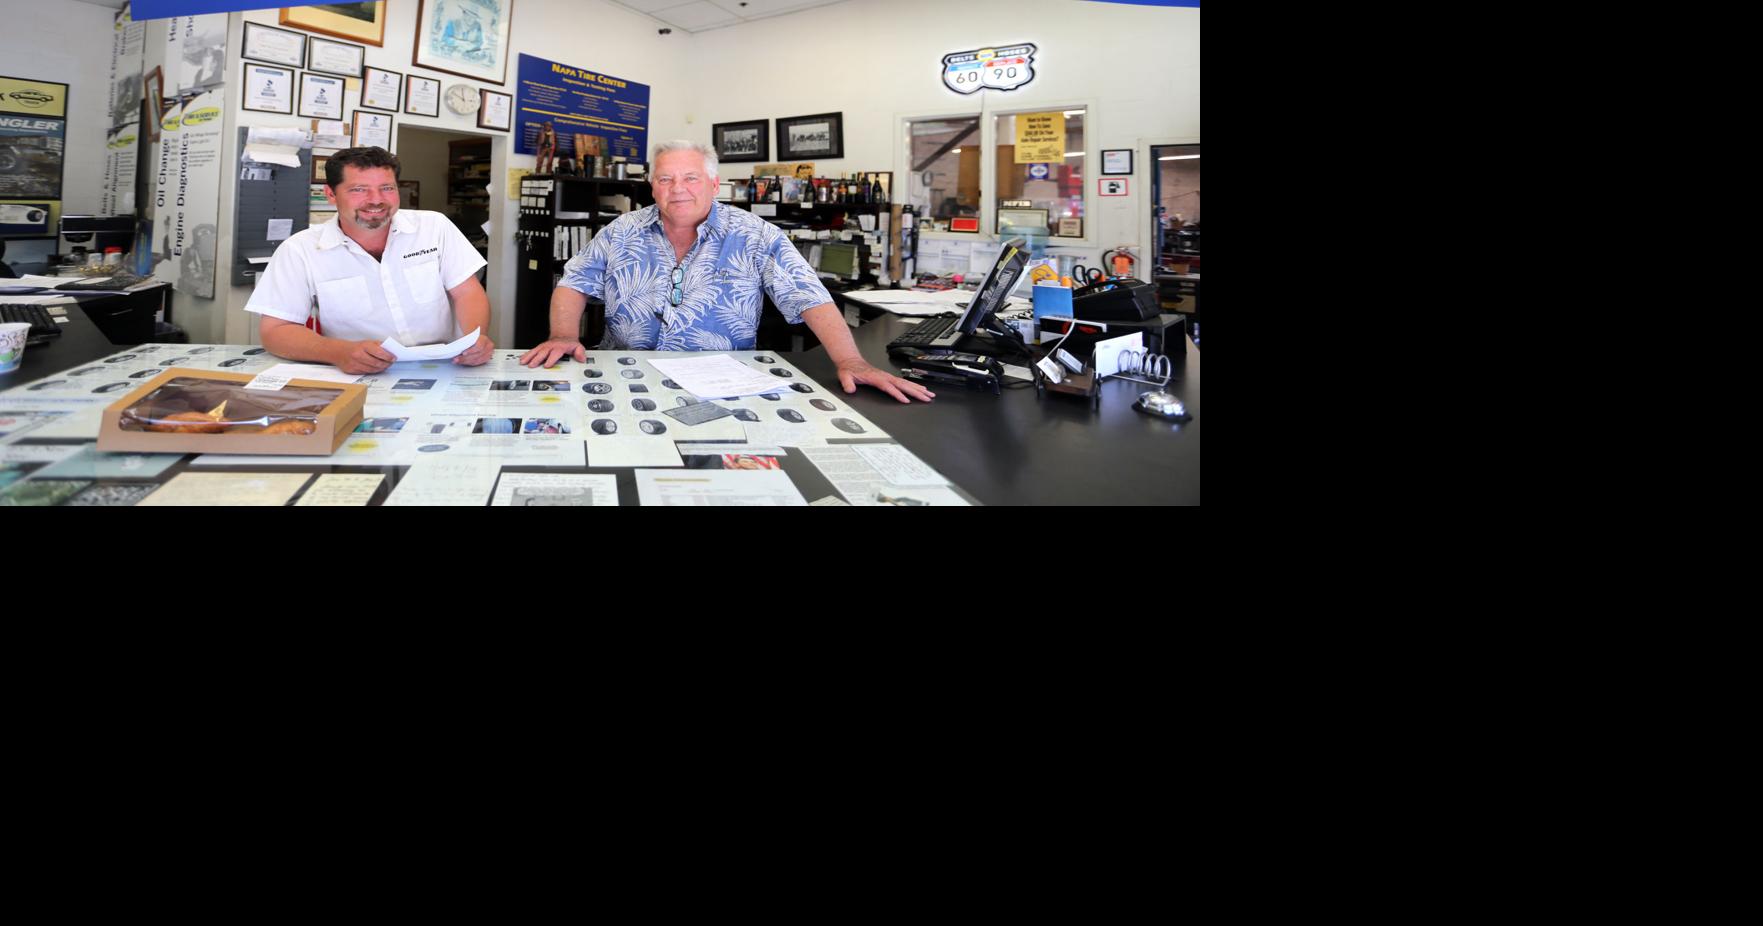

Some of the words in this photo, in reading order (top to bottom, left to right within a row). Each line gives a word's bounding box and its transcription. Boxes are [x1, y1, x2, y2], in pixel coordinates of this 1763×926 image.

[956, 71, 978, 84] 60
[993, 66, 1017, 80] 90
[158, 138, 170, 186] Change
[176, 132, 190, 207] Diagnostics
[156, 189, 166, 208] Oil
[174, 211, 186, 257] Engine
